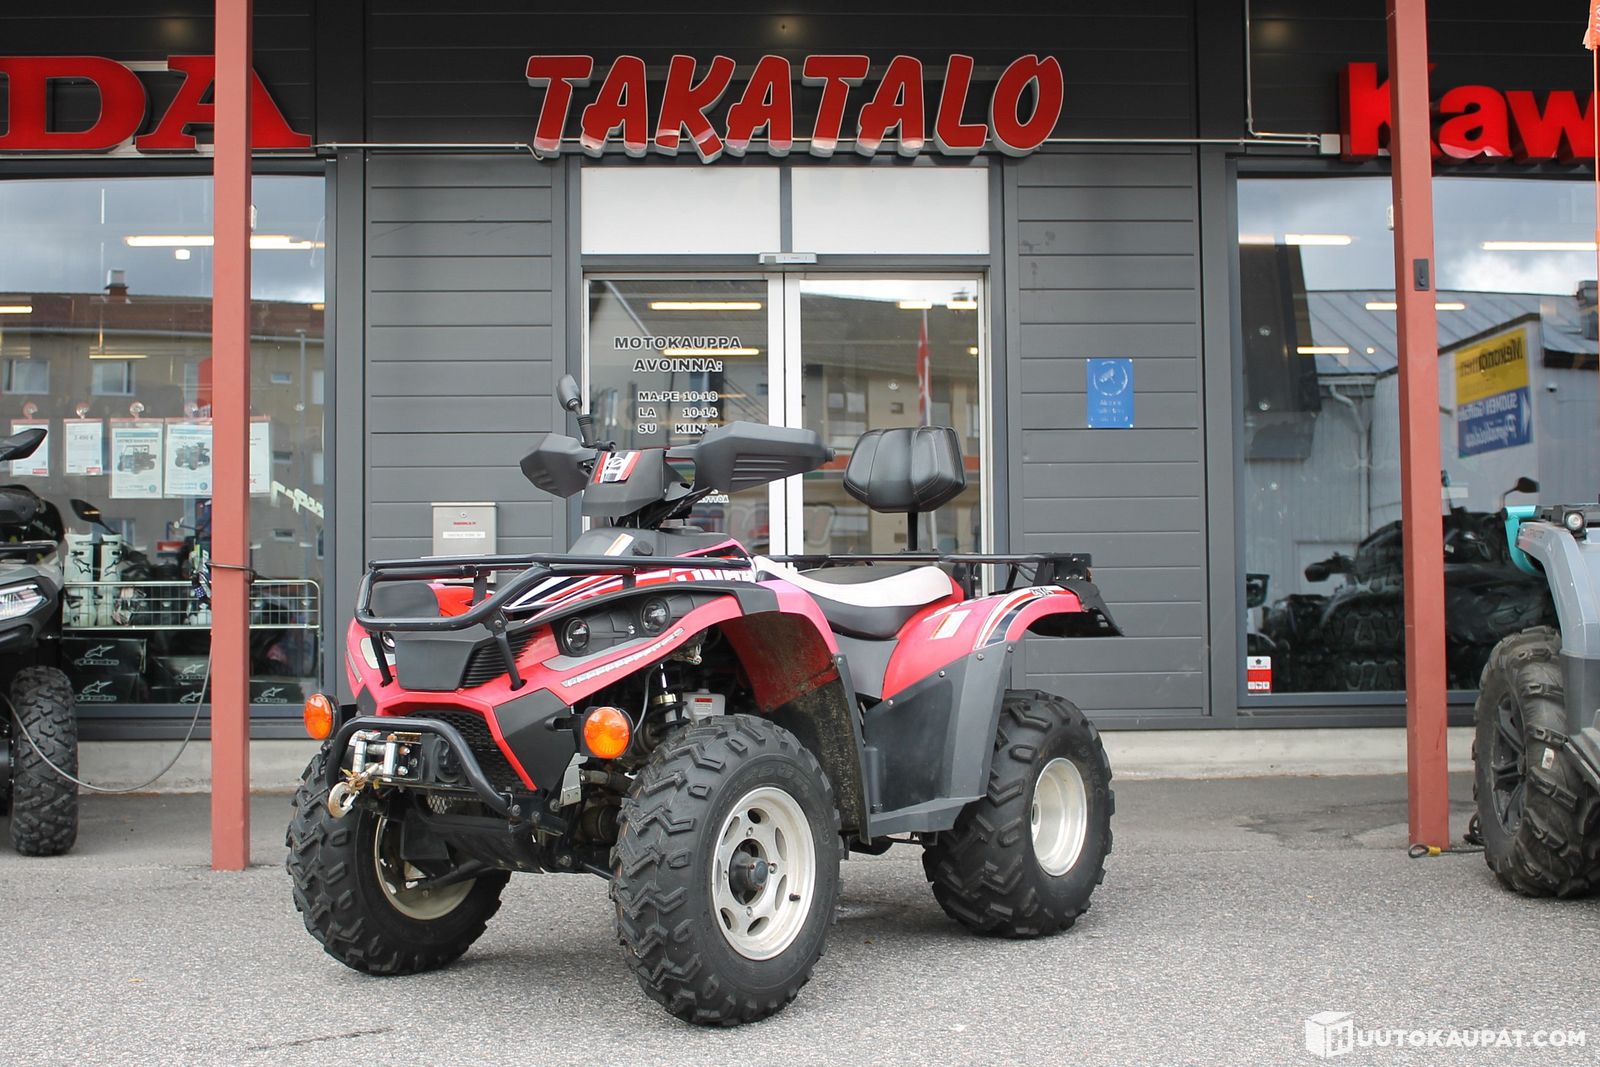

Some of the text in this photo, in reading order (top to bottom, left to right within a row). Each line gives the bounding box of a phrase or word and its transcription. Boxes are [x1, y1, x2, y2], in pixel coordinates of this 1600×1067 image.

[0, 54, 312, 150] DA
[525, 54, 1065, 163] TAKATALO
[614, 336, 742, 350] MOTOKAUPPA
[633, 359, 723, 372] AVOINNA:
[638, 391, 718, 401] MA-PE 10-18
[638, 407, 719, 418] LA 10-14
[638, 423, 657, 434] SU
